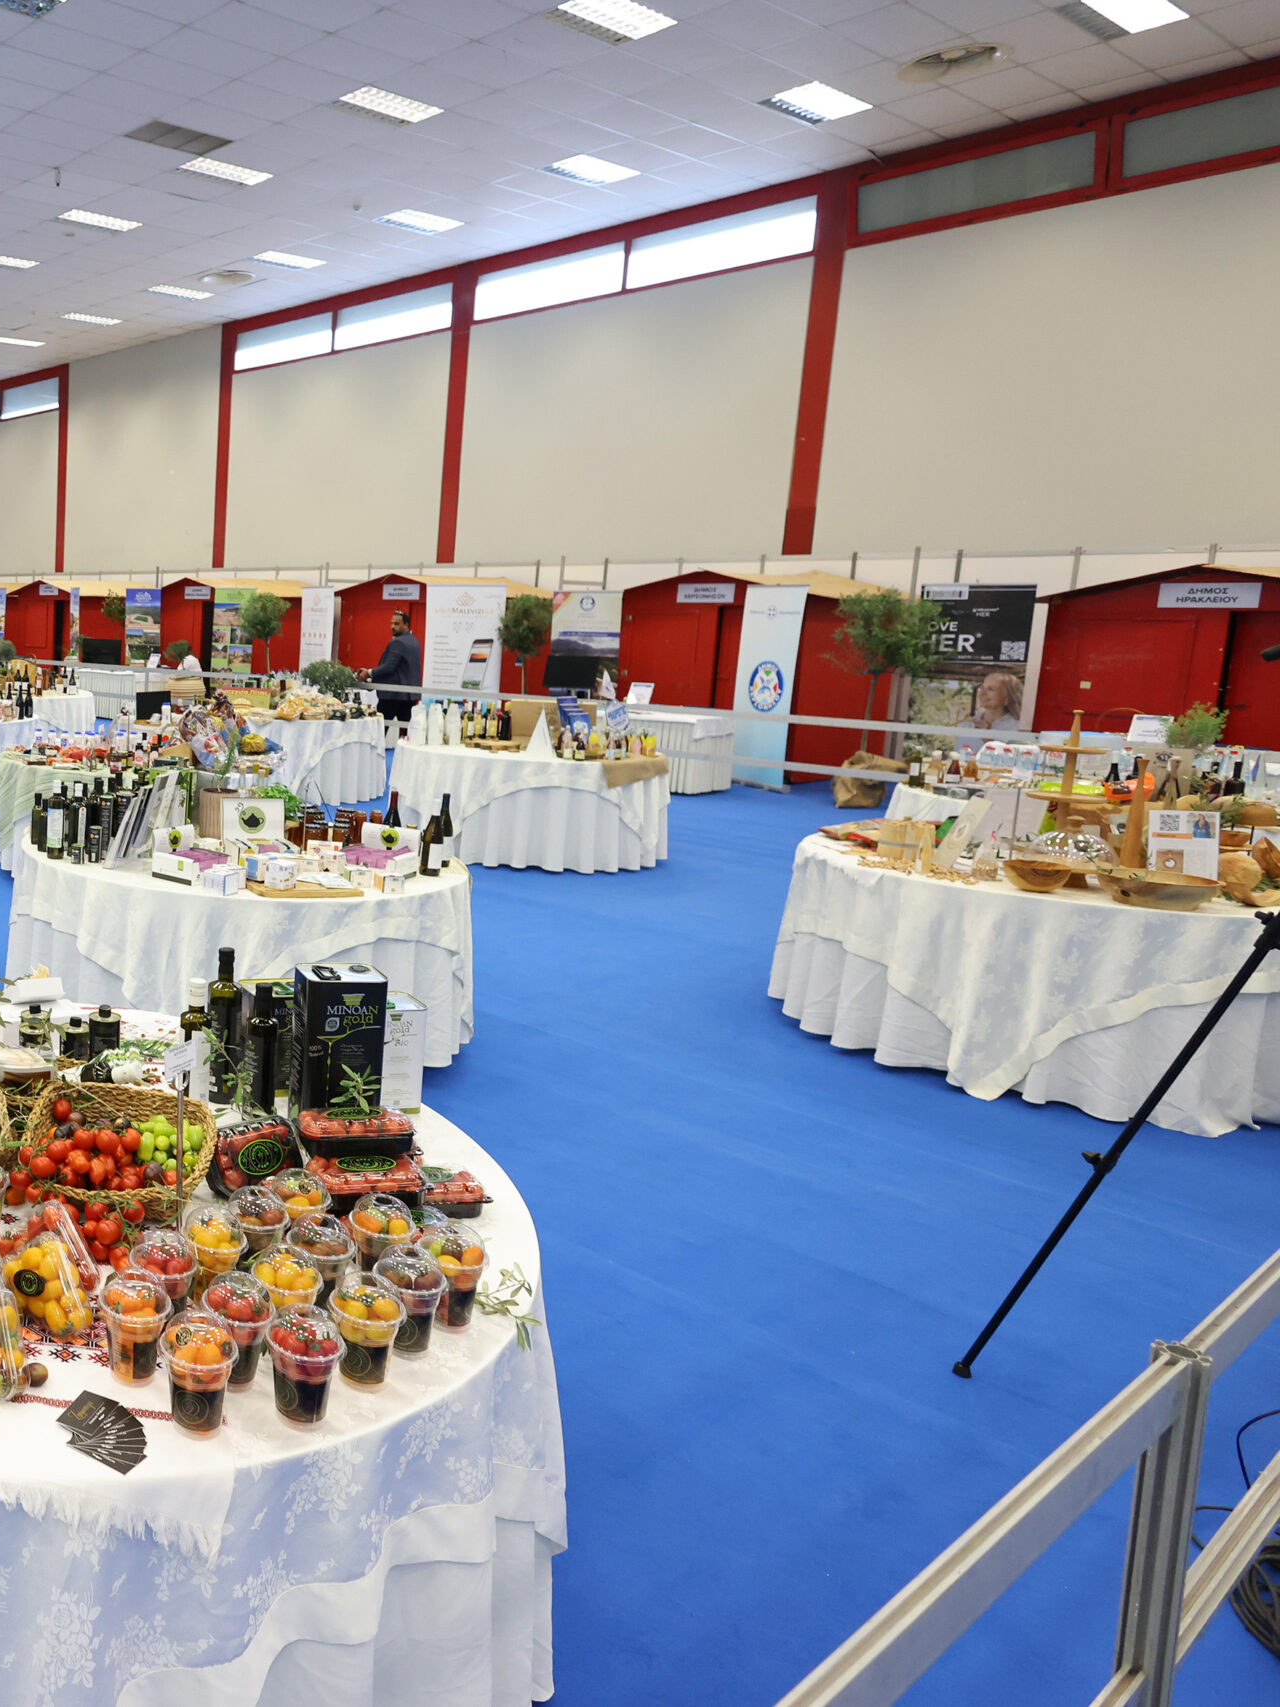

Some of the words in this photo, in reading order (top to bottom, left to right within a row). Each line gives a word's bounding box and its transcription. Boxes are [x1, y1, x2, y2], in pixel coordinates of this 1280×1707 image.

[1188, 587, 1229, 595] ΔΗΜΟΣ
[1176, 596, 1239, 604] ΗΡΑΚΛΕΙΟΥ
[928, 621, 959, 632] OVE
[326, 1005, 379, 1015] MINOAN
[343, 1013, 374, 1029] gold
